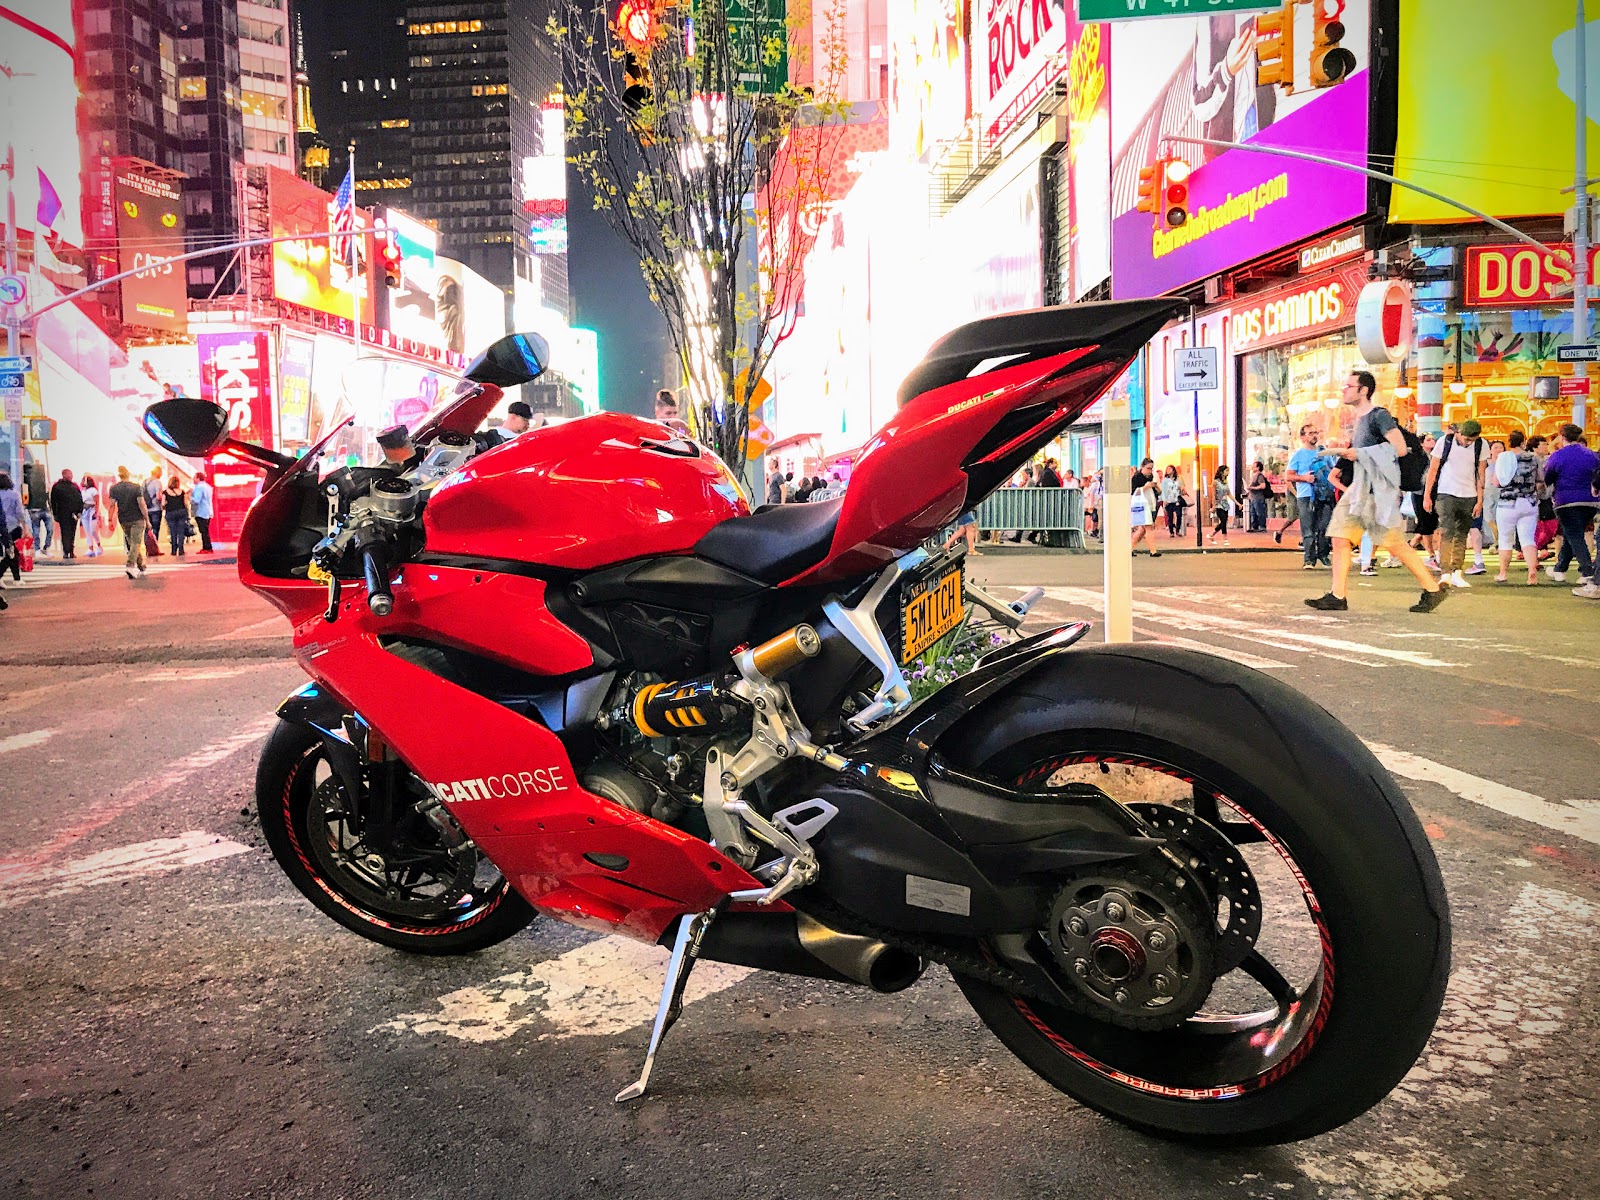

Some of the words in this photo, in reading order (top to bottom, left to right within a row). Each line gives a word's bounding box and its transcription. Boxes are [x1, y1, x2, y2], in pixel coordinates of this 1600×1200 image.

[140, 176, 157, 187] BACK
[157, 182, 171, 191] AND
[143, 184, 161, 196] THAN
[133, 252, 173, 279] CATS
[1479, 250, 1573, 298] DOS
[1233, 307, 1262, 347] DOS
[1264, 282, 1341, 337] CAMINOS
[1183, 359, 1209, 368] TRAFFIC
[1188, 350, 1203, 359] ALL
[1564, 350, 1581, 358] ONE
[216, 341, 259, 431] tkts
[947, 395, 982, 414] DUCATI
[914, 632, 936, 654] EMPIRE
[936, 617, 954, 637] STATE
[1217, 793, 1321, 910] SUPERBIKE
[1113, 1071, 1239, 1098] SUPERBIKE
